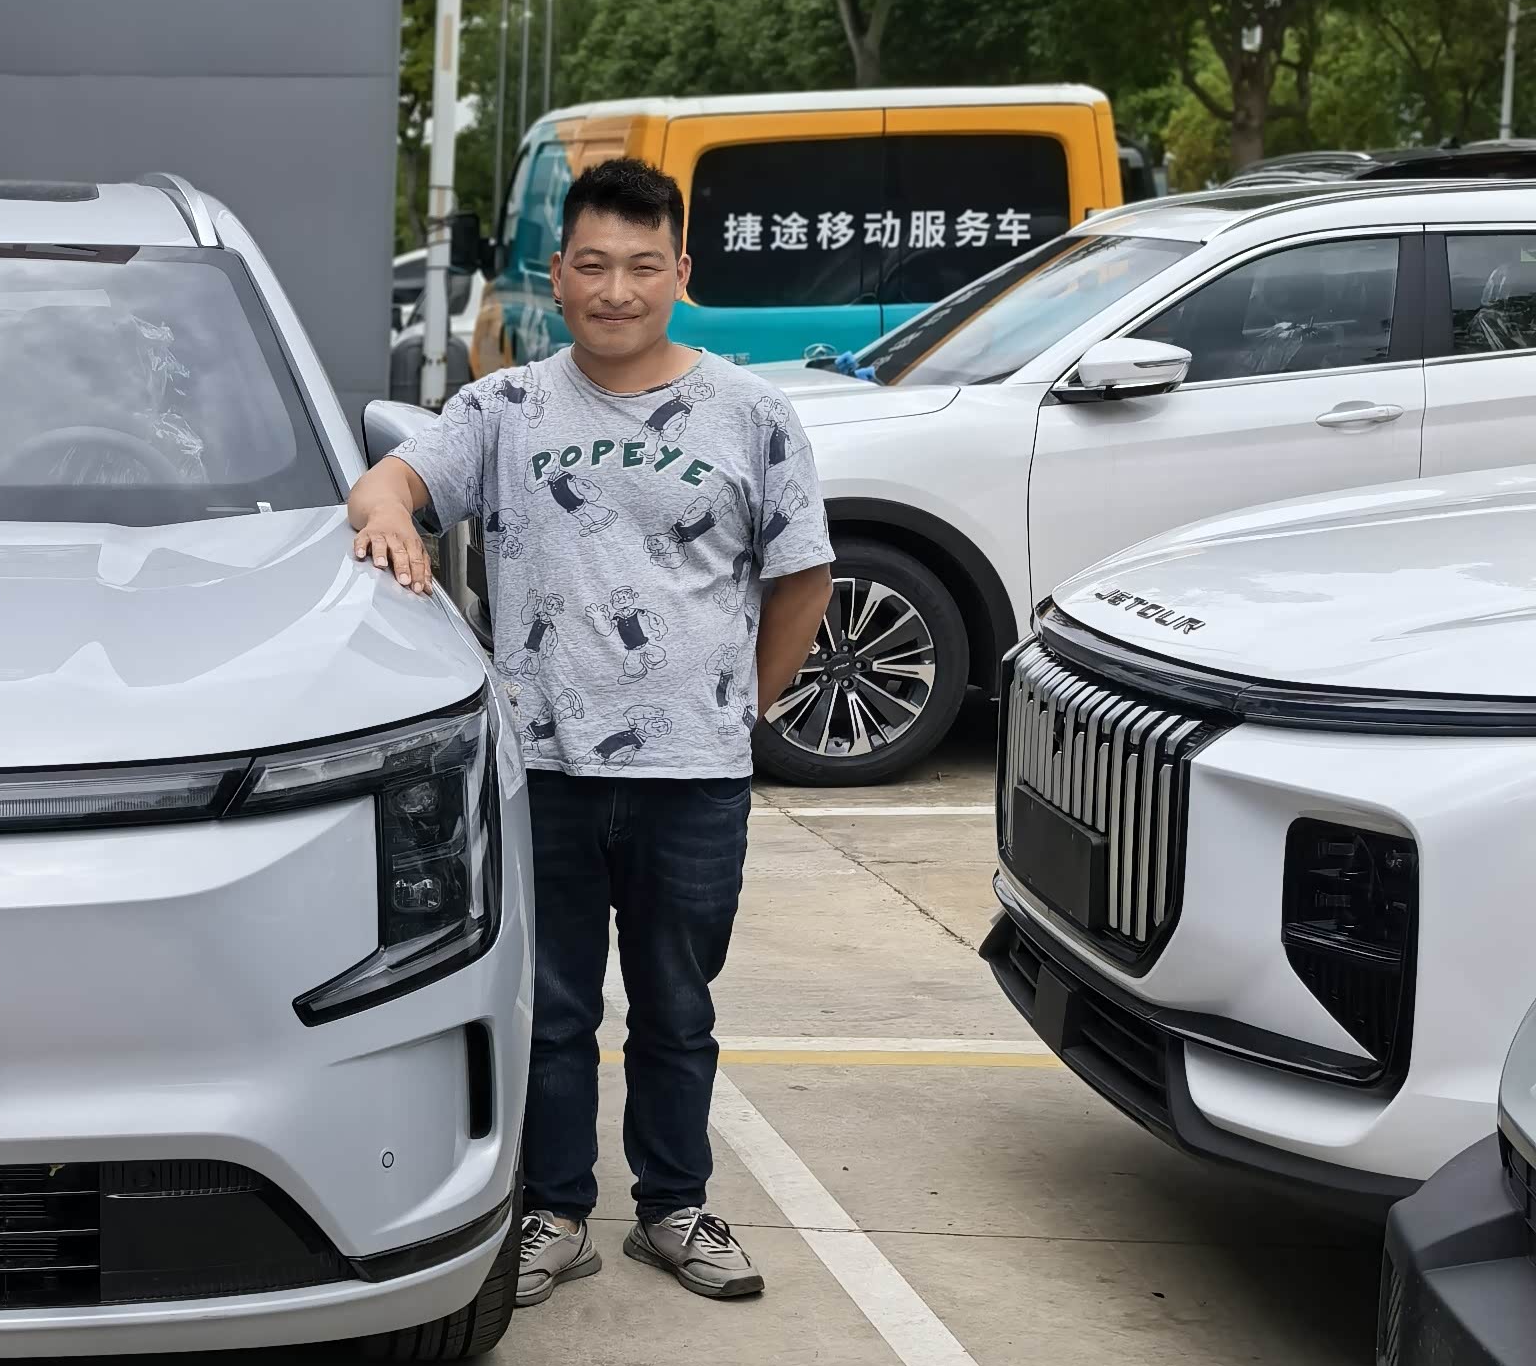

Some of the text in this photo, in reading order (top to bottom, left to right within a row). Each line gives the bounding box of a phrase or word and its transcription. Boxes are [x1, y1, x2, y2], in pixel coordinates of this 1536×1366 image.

[724, 208, 1031, 251] 捷途移动服务车
[531, 439, 715, 487] POPEYE
[1094, 589, 1206, 634] JETOUR
